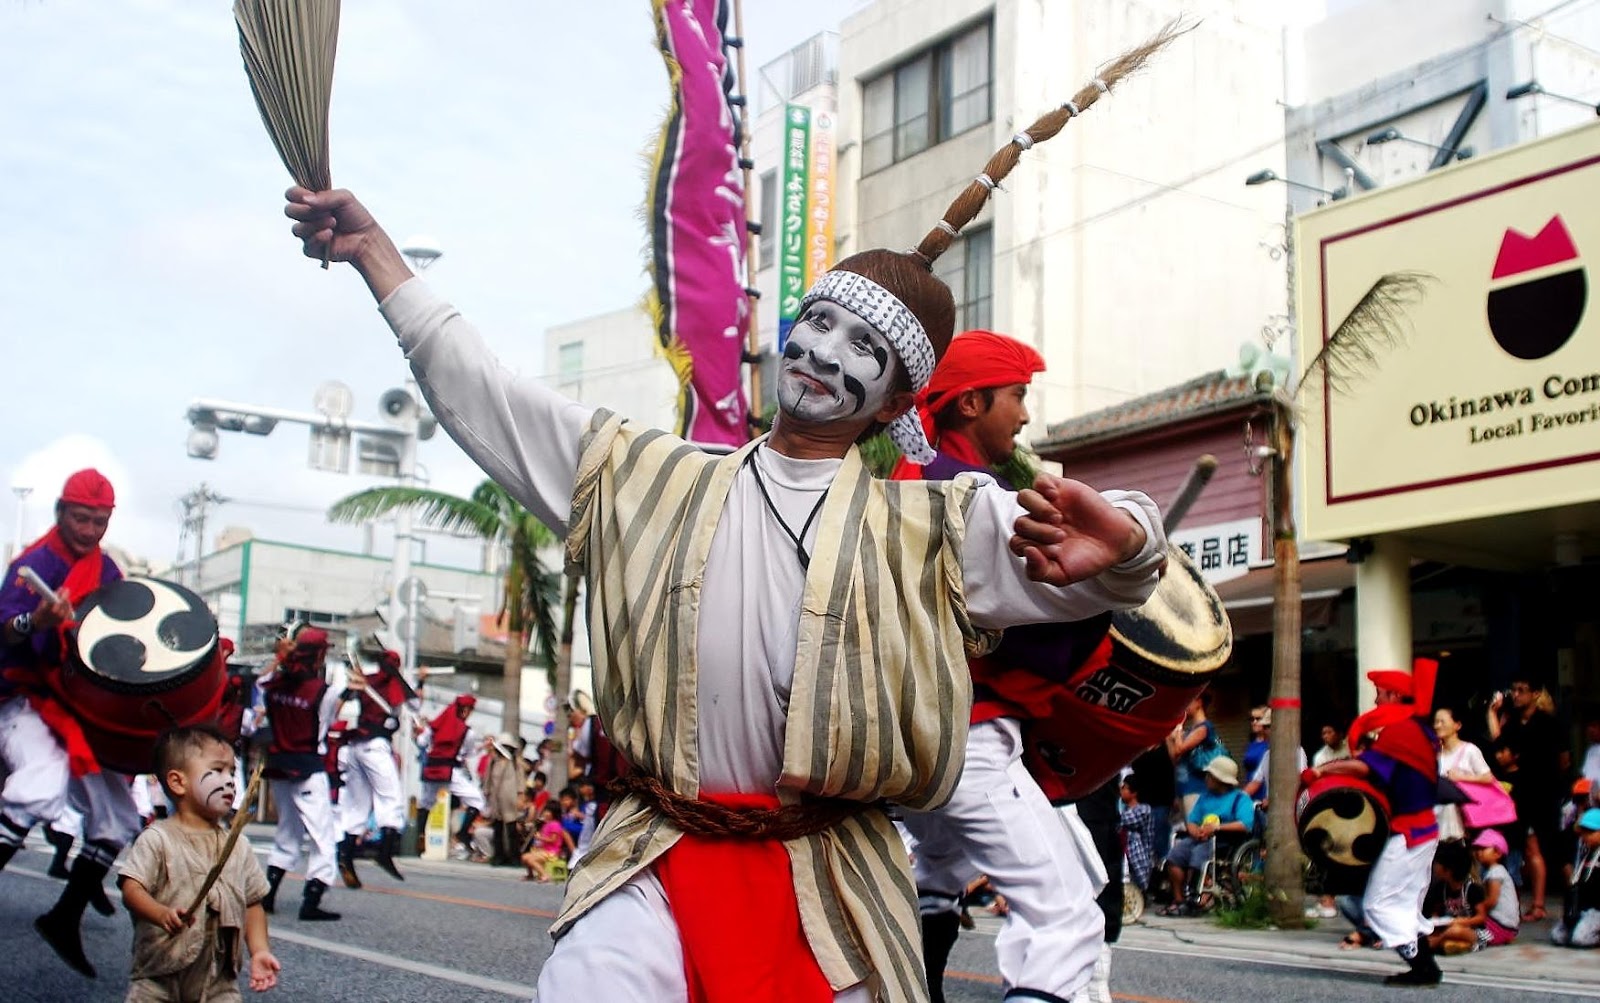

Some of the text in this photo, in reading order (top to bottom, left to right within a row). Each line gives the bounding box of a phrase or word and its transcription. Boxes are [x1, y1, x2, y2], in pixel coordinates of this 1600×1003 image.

[1410, 386, 1534, 426] Okinawa
[1470, 402, 1600, 444] Local Favori
